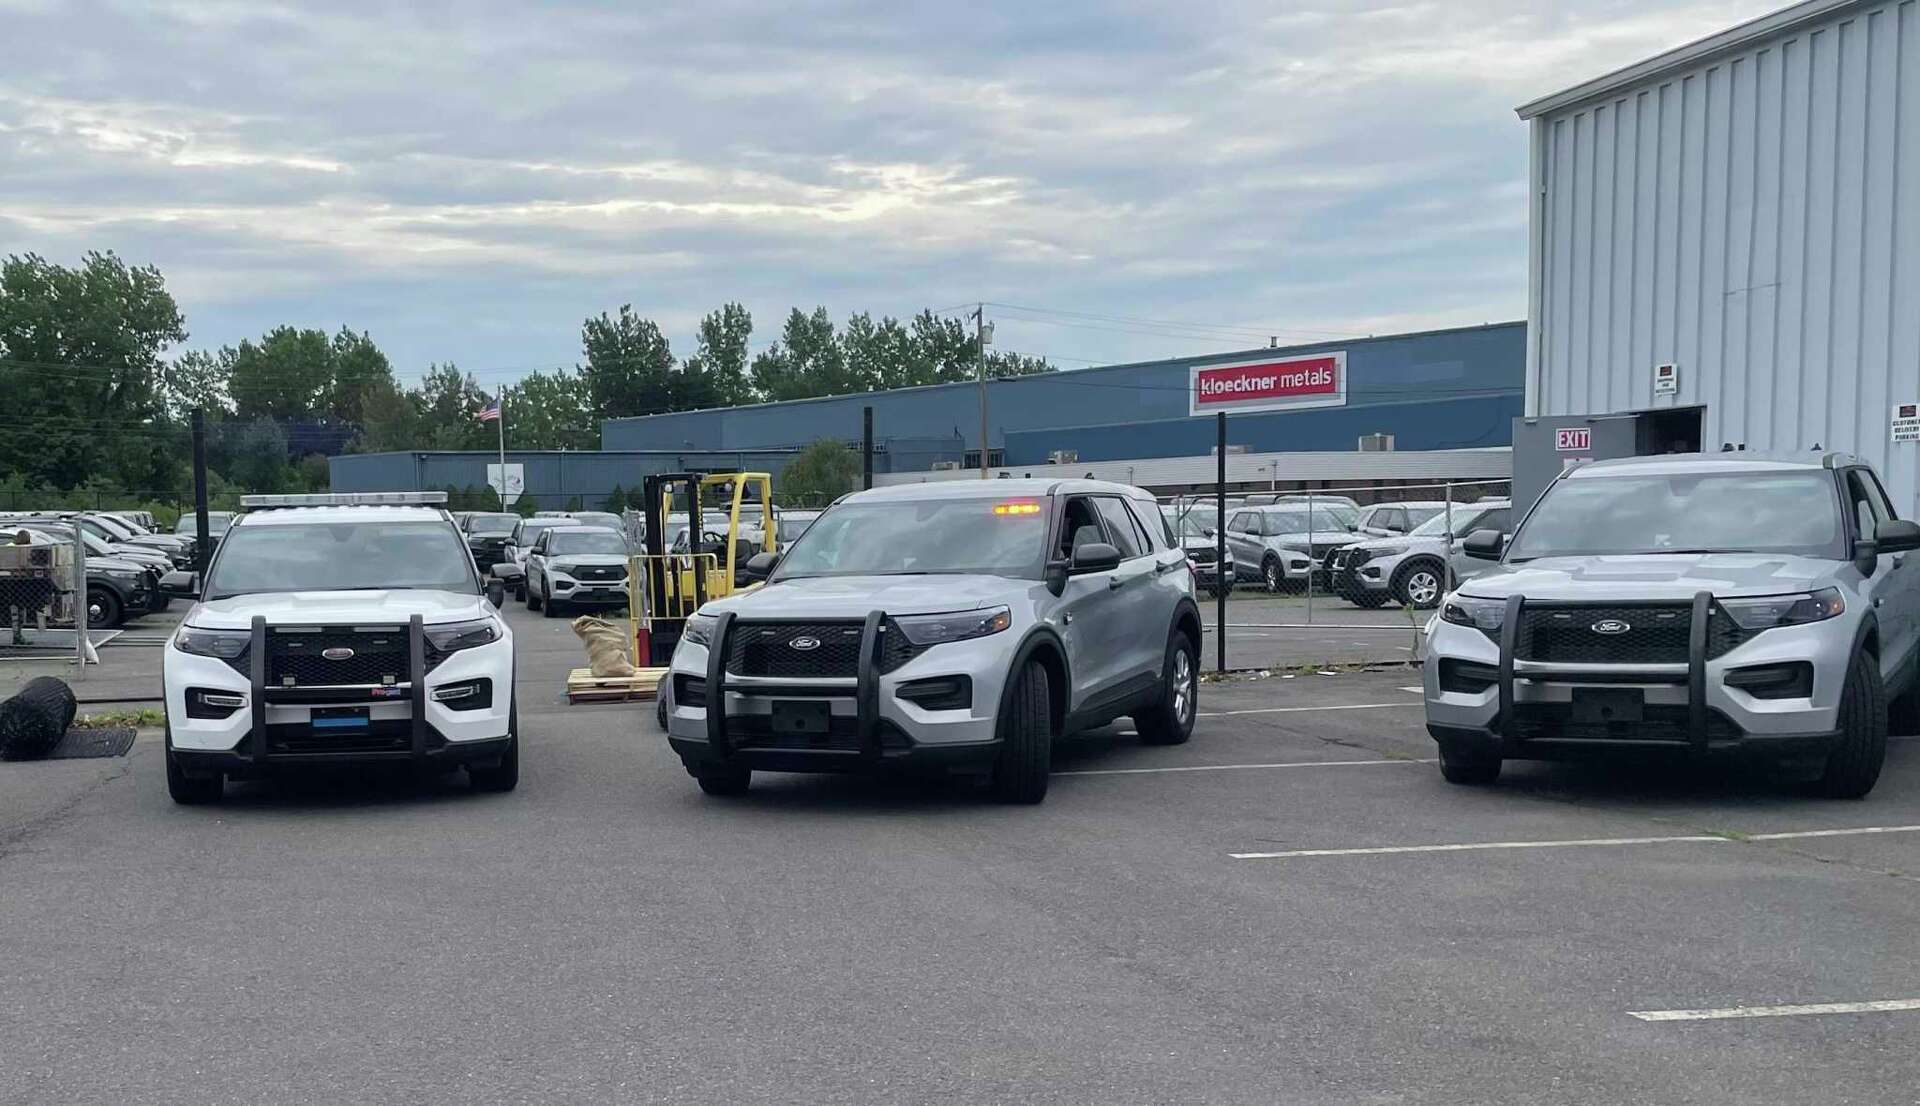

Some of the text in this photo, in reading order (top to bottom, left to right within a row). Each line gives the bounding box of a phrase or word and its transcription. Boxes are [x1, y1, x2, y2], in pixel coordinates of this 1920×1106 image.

[1201, 367, 1332, 395] kloeckner metals
[1559, 430, 1588, 448] EXIT
